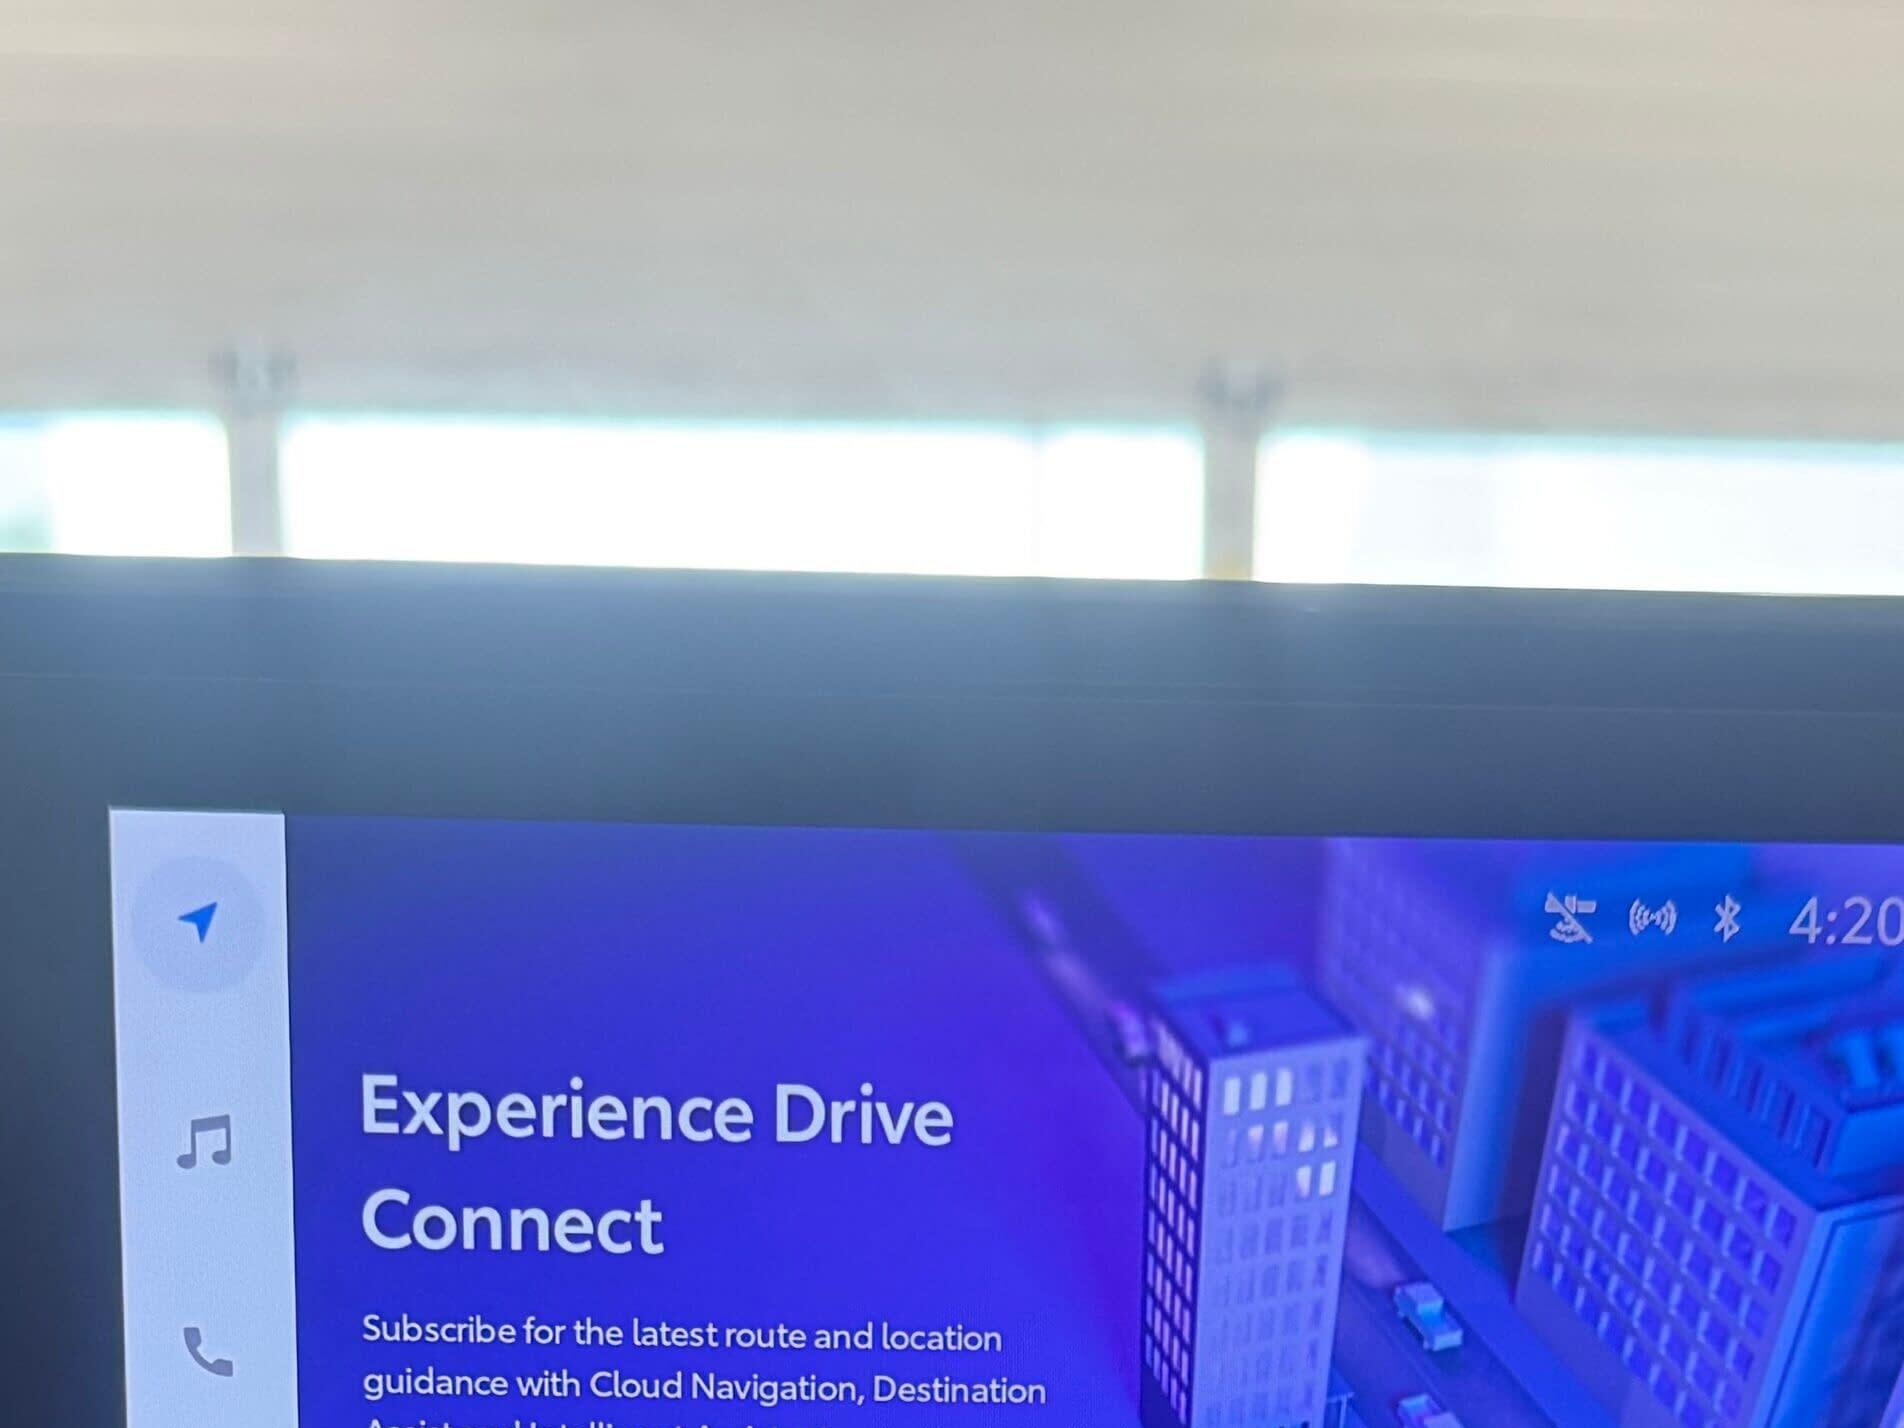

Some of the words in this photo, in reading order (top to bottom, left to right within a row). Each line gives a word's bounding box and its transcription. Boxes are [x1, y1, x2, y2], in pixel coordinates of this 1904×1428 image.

[362, 1073, 754, 1152] Experience
[776, 1082, 954, 1146] Drive
[362, 1188, 664, 1255] Connect
[362, 1312, 517, 1345] Subscribe
[522, 1314, 567, 1347] for
[573, 1315, 625, 1348] the
[633, 1317, 719, 1348] latest
[725, 1323, 807, 1349] route
[814, 1321, 873, 1350] and
[882, 1321, 1002, 1352] location
[363, 1366, 509, 1401] guidance
[516, 1368, 581, 1397] with
[589, 1369, 682, 1399] Cloud
[692, 1372, 865, 1407] Navigation,
[873, 1375, 1046, 1404] Destination
